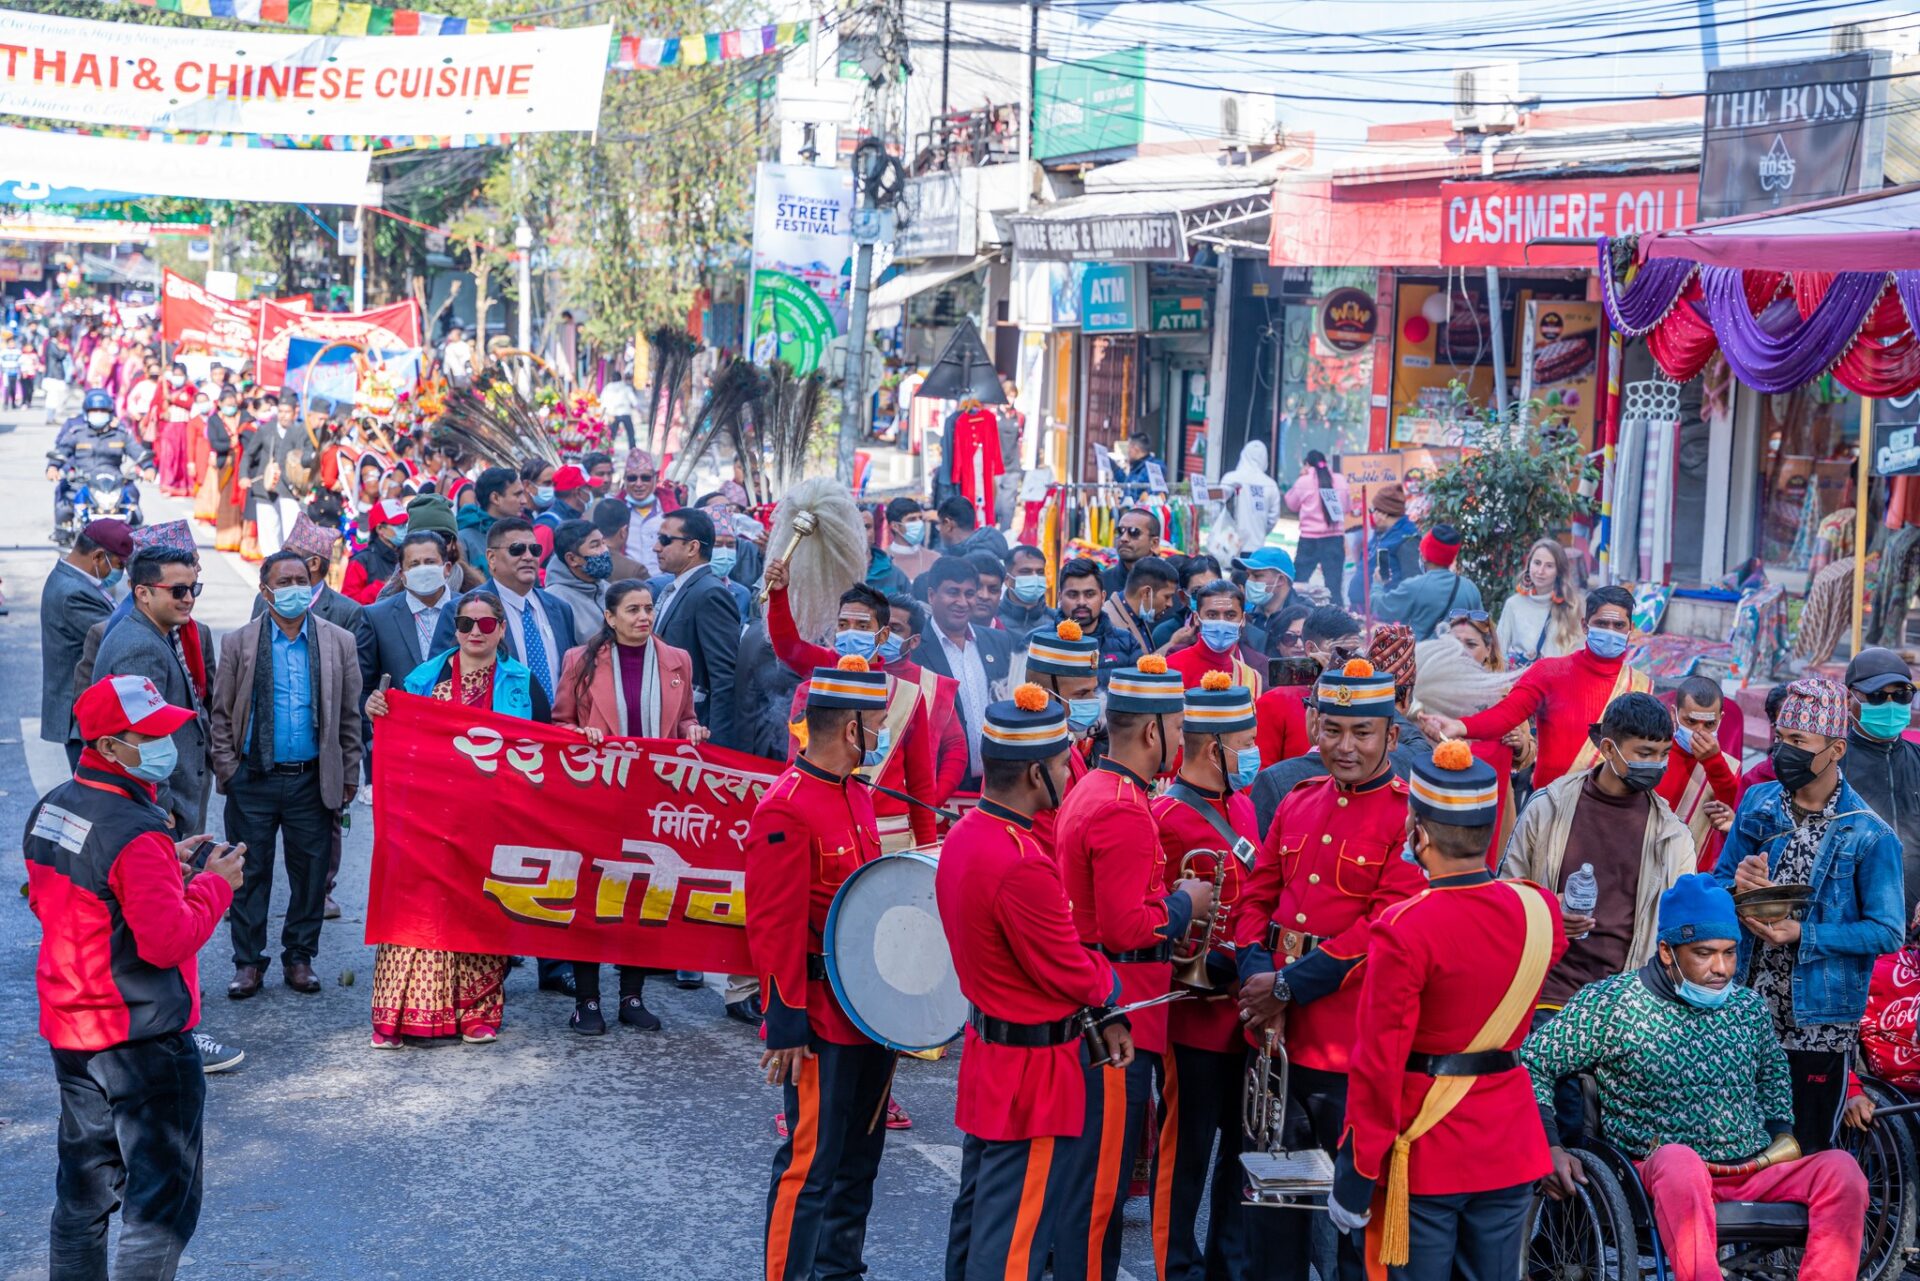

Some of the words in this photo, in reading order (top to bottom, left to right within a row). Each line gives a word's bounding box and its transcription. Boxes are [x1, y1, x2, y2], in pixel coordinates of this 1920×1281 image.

[0, 43, 119, 90] THAI
[133, 57, 164, 92] &
[174, 61, 364, 99] CHINESE
[375, 64, 534, 98] CUISINE
[1712, 89, 1770, 129] THE
[1779, 82, 1858, 123] BOSS
[1759, 159, 1795, 176] BOSS
[775, 219, 838, 235] FESTIVAL
[777, 203, 839, 222] STREET
[1449, 192, 1604, 244] CASHMERE
[1092, 219, 1171, 250] HANDICRAFTS
[1090, 277, 1125, 304] ATM
[1158, 314, 1197, 330] ATM
[452, 727, 545, 784] २३
